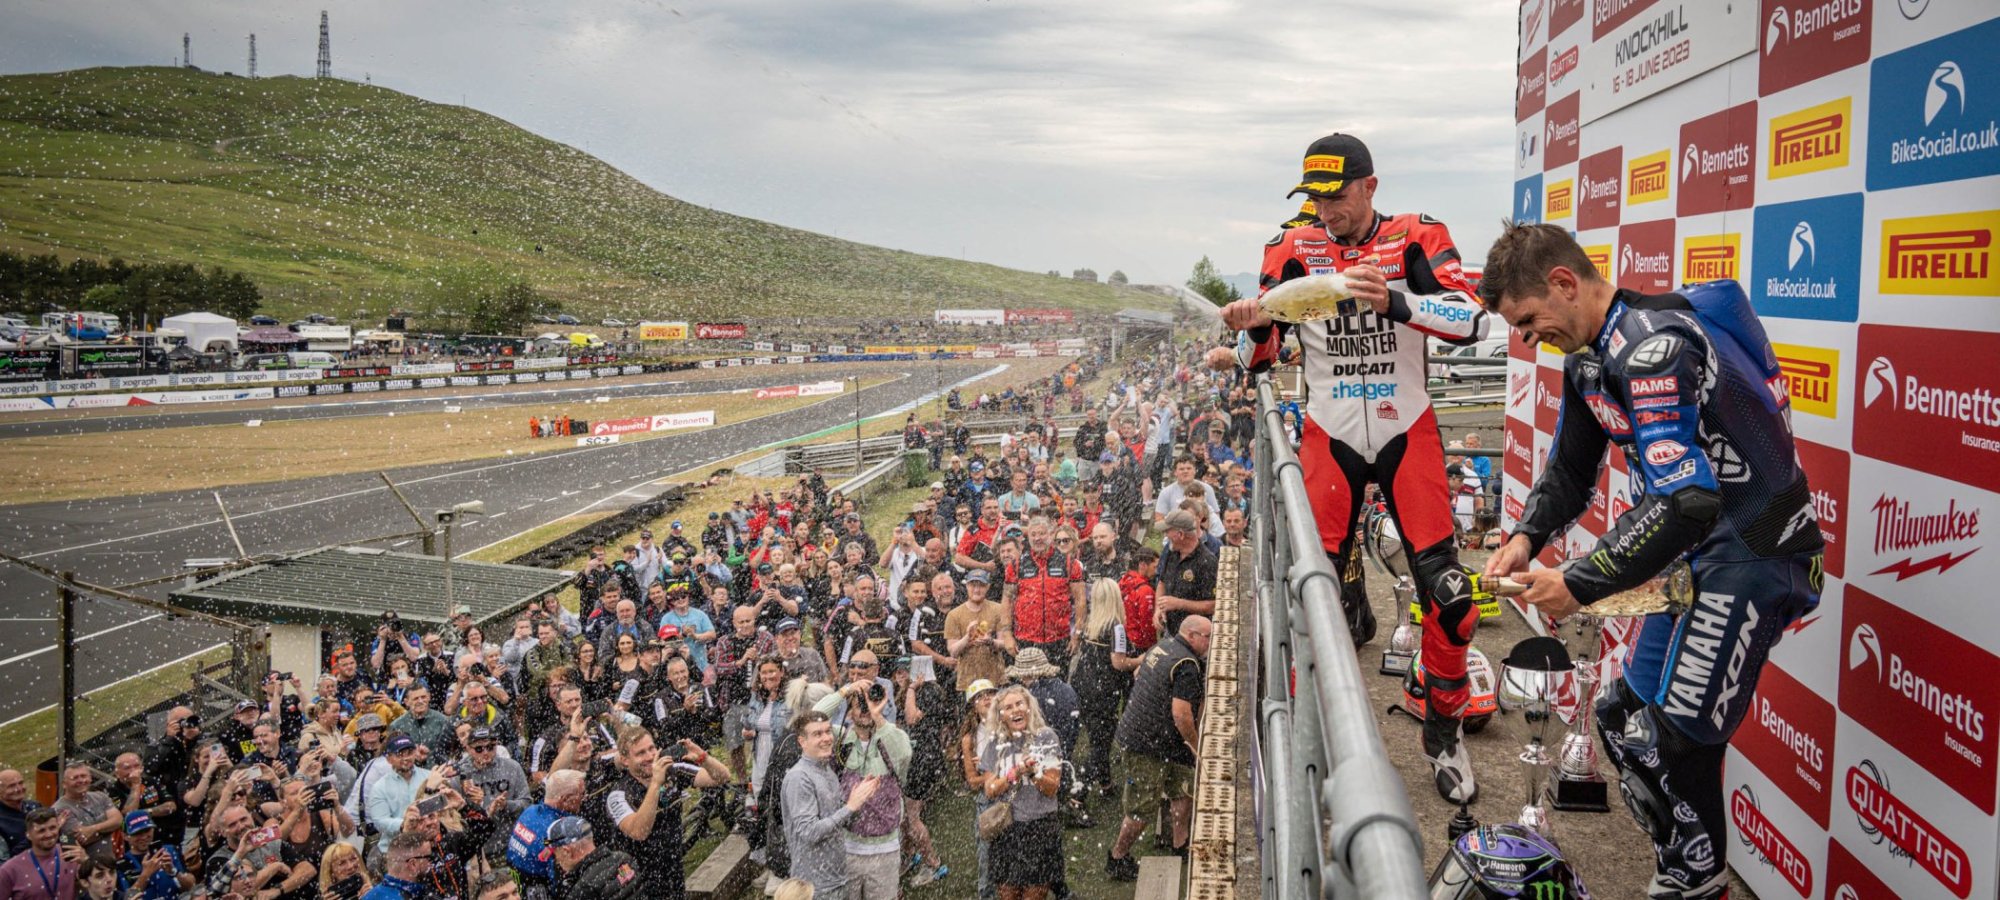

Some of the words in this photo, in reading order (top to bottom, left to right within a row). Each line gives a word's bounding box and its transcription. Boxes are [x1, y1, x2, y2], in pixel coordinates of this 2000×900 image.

[1794, 0, 1861, 39] Bennetts
[1833, 22, 1861, 41] Insurance
[1615, 5, 1689, 67] KNOCKHILL
[1612, 75, 1620, 94] 16
[1625, 68, 1634, 88] 18
[1635, 52, 1660, 83] JUNE
[1662, 39, 1690, 70] 2023
[1555, 118, 1578, 141] Bennetts
[1774, 113, 1843, 168] PIRELLI
[1891, 121, 1999, 165] BikeSocial.co.uk
[1305, 158, 1339, 170] PIRELLI
[1702, 142, 1749, 174] Bennetts
[1590, 176, 1618, 199] Bennetts
[1630, 161, 1666, 196] PIRELLI
[1729, 174, 1748, 184] Insurance
[1548, 187, 1570, 213] PIRELLI
[1634, 252, 1669, 273] Bennetts
[1687, 246, 1735, 279] PIRELLI
[1888, 229, 1992, 279] PIRELLI
[1379, 264, 1400, 274] WIN
[1767, 277, 1836, 298] BikeSocial.co.uk
[1326, 332, 1397, 357] MONSTER
[181, 375, 213, 385] xograph
[236, 373, 267, 382] xograph
[1333, 362, 1395, 376] DUCATI
[0, 384, 39, 394] xograph
[122, 376, 157, 388] xograph
[769, 388, 796, 397] Bennetts
[1631, 379, 1677, 394] DAMS
[1546, 390, 1562, 411] Benne
[1904, 375, 2000, 428] Bennetts
[611, 422, 648, 432] Bennetts
[672, 417, 710, 427] Bennetts
[1962, 431, 2000, 453] Insurance
[1506, 494, 1524, 520] QUATT
[1610, 501, 1668, 556] MONSTER
[1871, 493, 1980, 555] Milwaukee
[1663, 591, 1735, 718] YAMAHA
[1889, 653, 1984, 743] Bennetts
[1761, 697, 1824, 773] Bennetts
[1944, 731, 1982, 767] Insurance
[1796, 762, 1821, 793] Insurance
[1852, 773, 1961, 886] QUATTRO
[1735, 798, 1806, 888] QUATTRO
[1490, 860, 1527, 872] Hanworth
